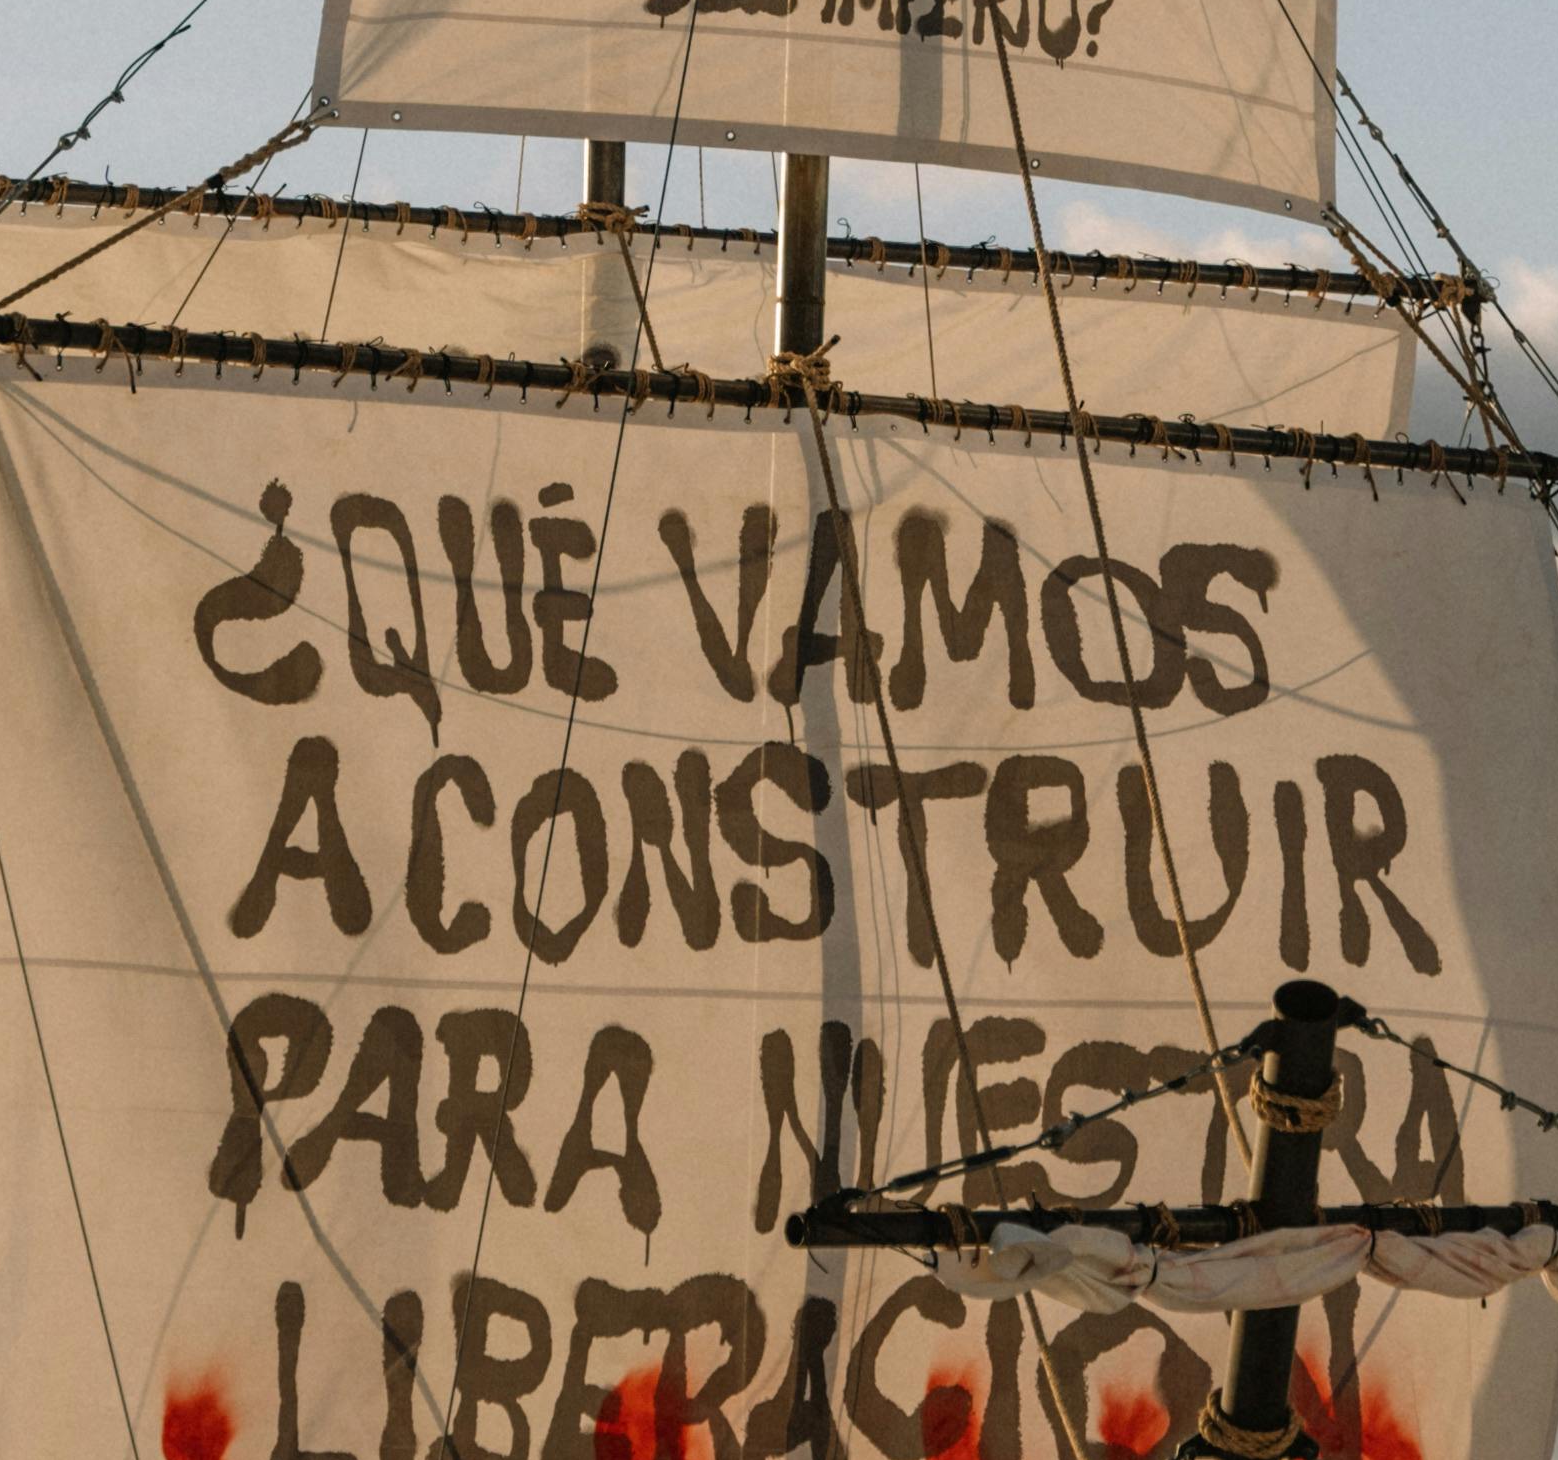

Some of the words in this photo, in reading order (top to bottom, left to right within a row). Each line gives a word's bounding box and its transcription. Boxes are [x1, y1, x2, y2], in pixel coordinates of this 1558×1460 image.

[193, 477, 619, 735] ¿QUÉ
[658, 505, 1281, 720] VAMOS
[229, 736, 372, 940] A
[405, 741, 1442, 976] CONSTRUIR
[208, 991, 662, 1240] PARA
